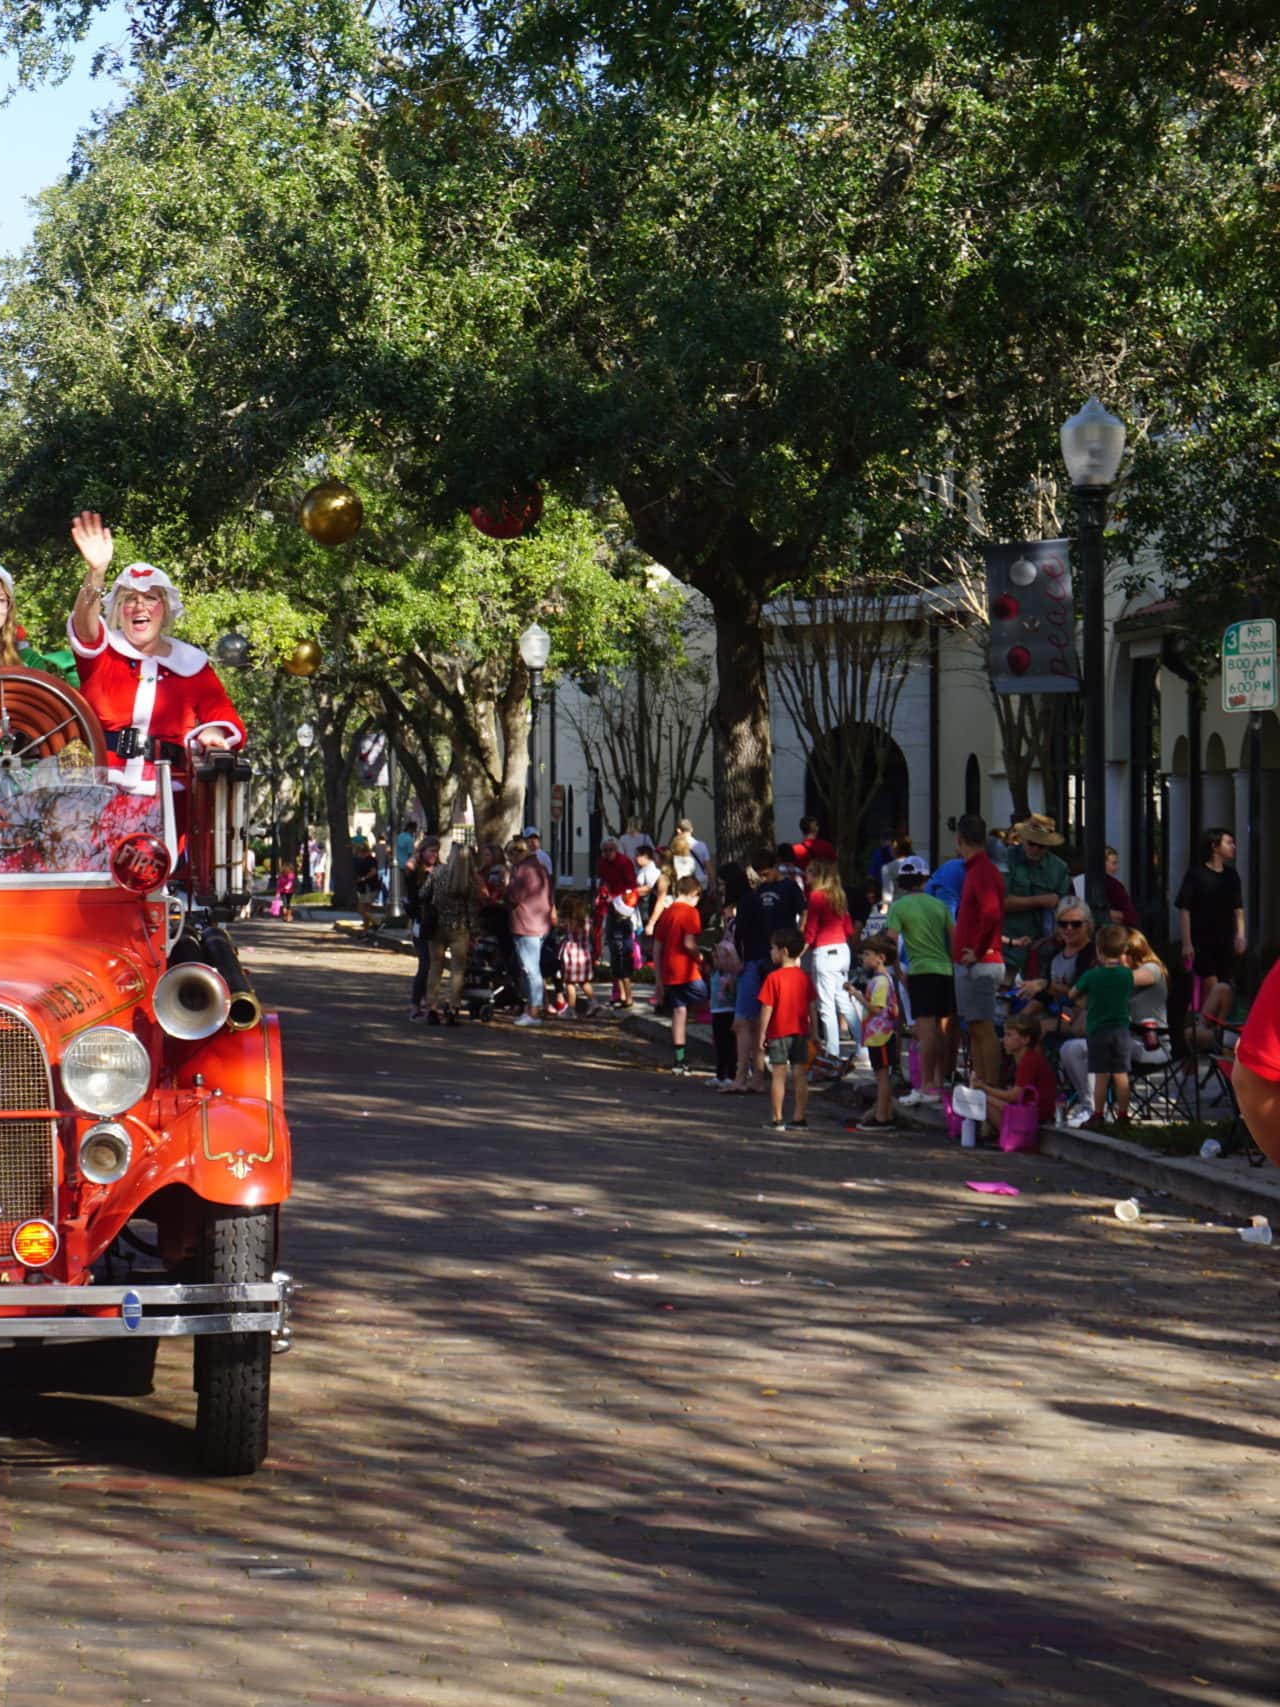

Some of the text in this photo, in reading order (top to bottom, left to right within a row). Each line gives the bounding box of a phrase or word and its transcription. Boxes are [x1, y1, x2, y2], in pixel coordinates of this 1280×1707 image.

[1226, 630, 1237, 649] 3
[1242, 670, 1256, 680] TO
[117, 843, 166, 880] FIRE
